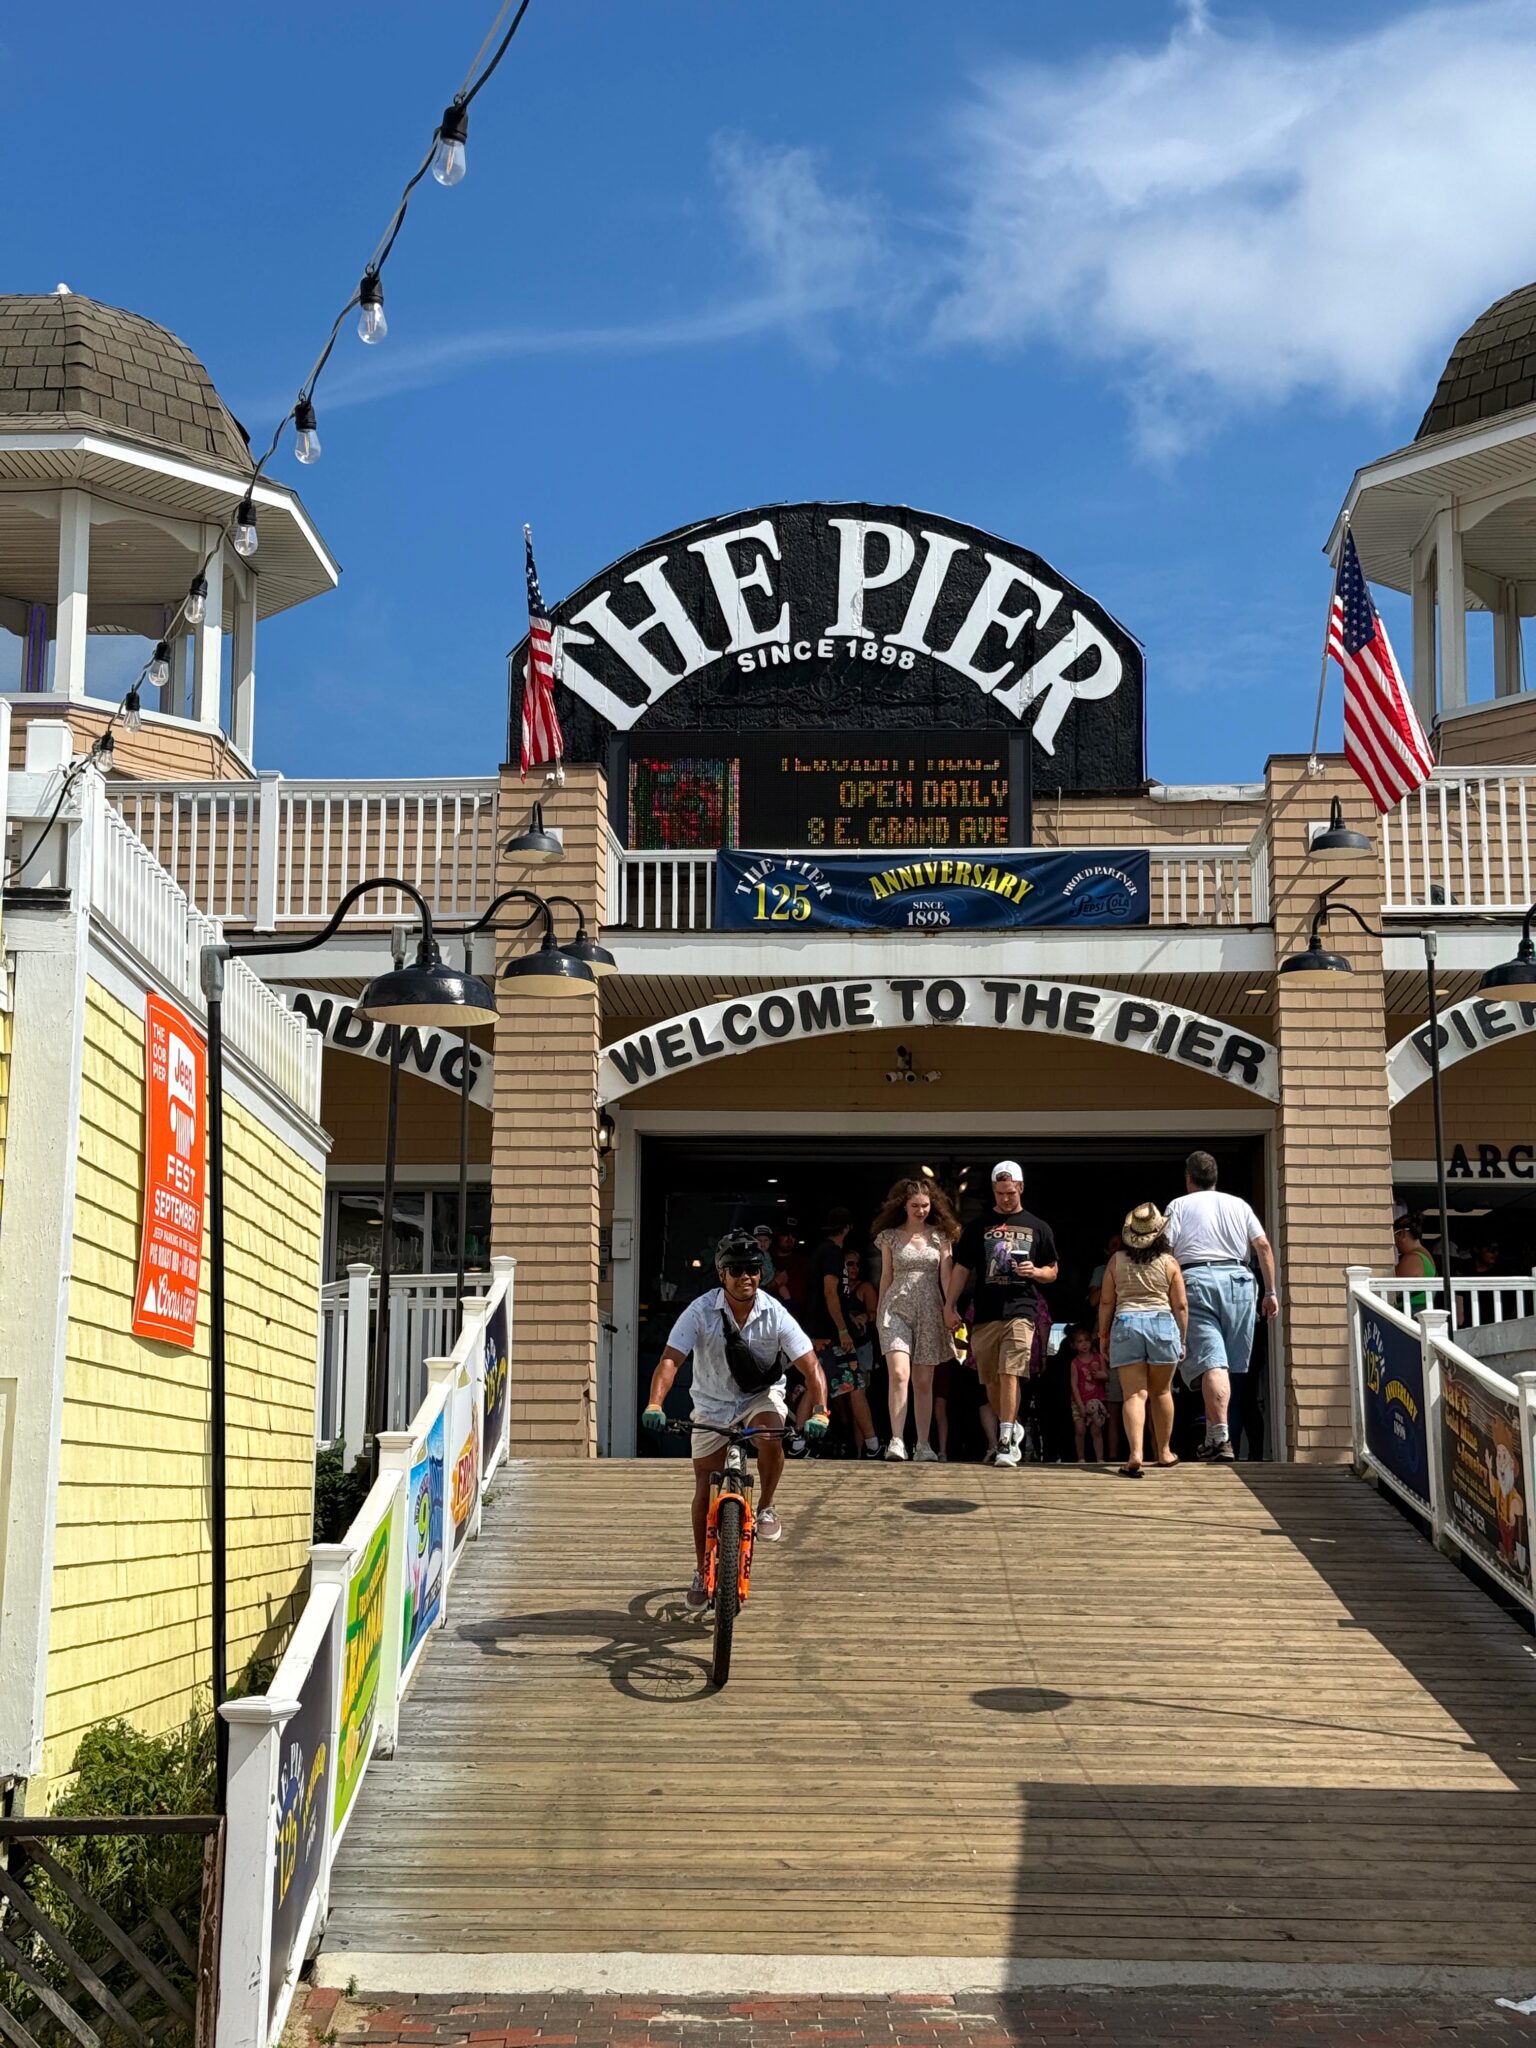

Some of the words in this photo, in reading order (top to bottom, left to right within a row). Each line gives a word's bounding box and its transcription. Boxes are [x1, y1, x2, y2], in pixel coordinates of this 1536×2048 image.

[524, 520, 790, 731] THE
[825, 518, 1122, 756] PIER
[737, 640, 833, 673] SINCE
[845, 639, 916, 670] 1898
[839, 780, 912, 807] OPEN
[922, 780, 1008, 807] DAILY
[808, 817, 825, 845] 8
[834, 817, 859, 844] E.
[869, 817, 950, 844] GRAND
[959, 817, 1008, 844] AVE
[735, 858, 776, 895] THE
[785, 859, 833, 900] PIER
[868, 860, 1035, 905] ANNIVERSARY
[1062, 868, 1094, 896] PROUD
[1094, 866, 1138, 896] PARTNER
[753, 882, 812, 921] 125
[907, 911, 951, 926] 1898
[912, 901, 945, 910] SINCE
[152, 1022, 165, 1043] THE
[290, 992, 482, 1092] NDING
[608, 983, 874, 1085] WELCOME
[890, 979, 966, 1021] TO
[985, 981, 1102, 1034] THE
[1114, 1000, 1268, 1085] PIER
[152, 1042, 166, 1063] OOB
[152, 1062, 166, 1083] PIER
[175, 1047, 193, 1102] Jeep
[166, 1153, 196, 1197] FEST
[154, 1188, 197, 1234] SEPTEMBER
[984, 1231, 1033, 1242] COMBS
[157, 1273, 180, 1320] Coors
